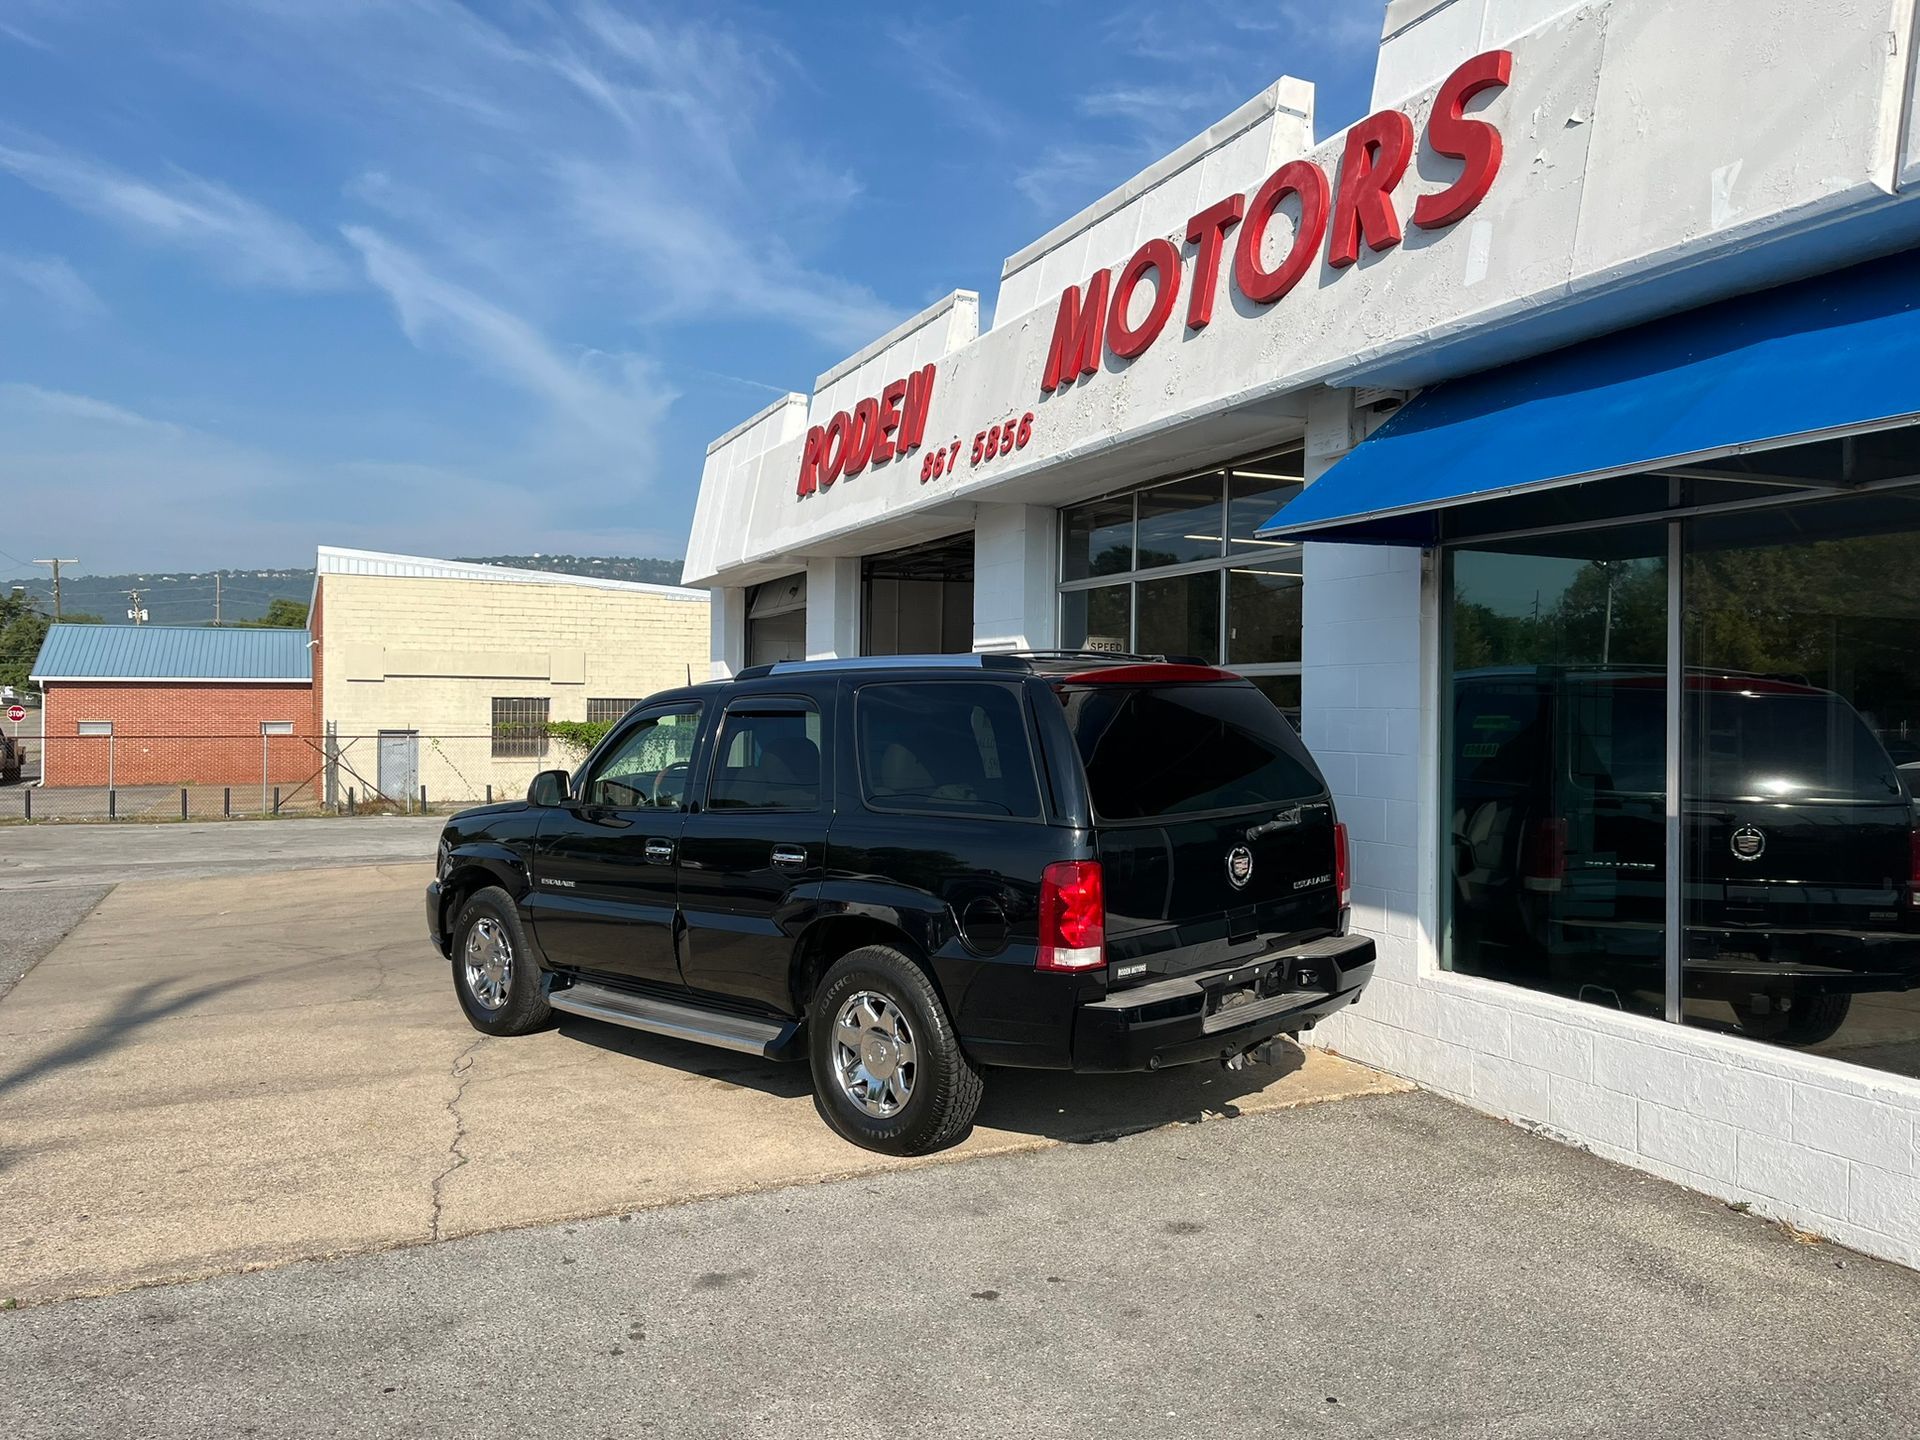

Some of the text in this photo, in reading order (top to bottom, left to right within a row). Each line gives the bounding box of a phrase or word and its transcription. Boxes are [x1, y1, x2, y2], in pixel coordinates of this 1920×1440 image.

[796, 49, 1512, 496] RODEN MOTORS
[920, 411, 1034, 484] 867 5856
[1090, 642, 1122, 652] SPEED
[8, 710, 25, 718] STOP
